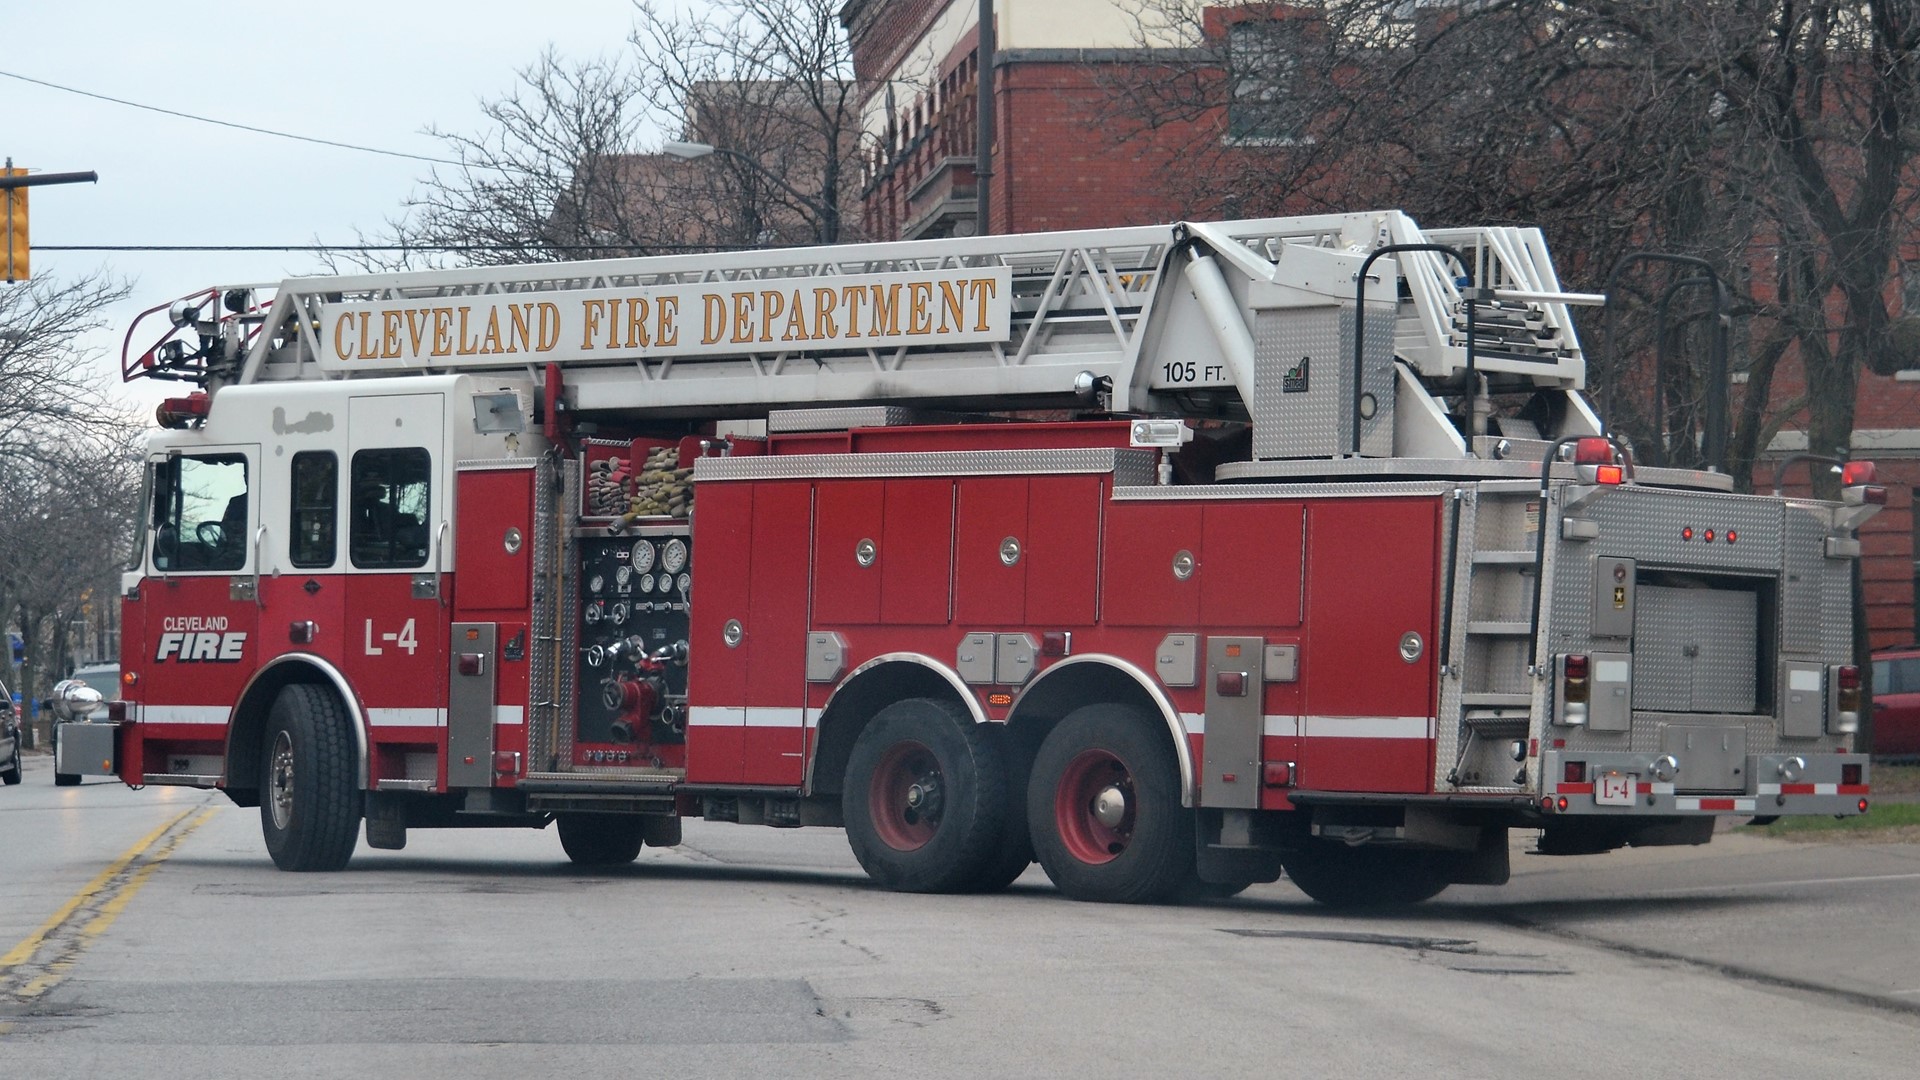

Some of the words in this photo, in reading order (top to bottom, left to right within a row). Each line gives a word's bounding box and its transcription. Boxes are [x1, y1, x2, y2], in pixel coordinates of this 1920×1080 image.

[334, 302, 561, 361] CLEVELAND
[580, 296, 679, 350] FIRE
[701, 278, 996, 345] DEPARTMENT
[1163, 361, 1196, 382] 105
[1205, 365, 1226, 381] FT.
[164, 616, 228, 632] CLEVELAND
[365, 618, 418, 655] L-4
[156, 632, 247, 662] FIRE
[1603, 779, 1628, 799] L-4
